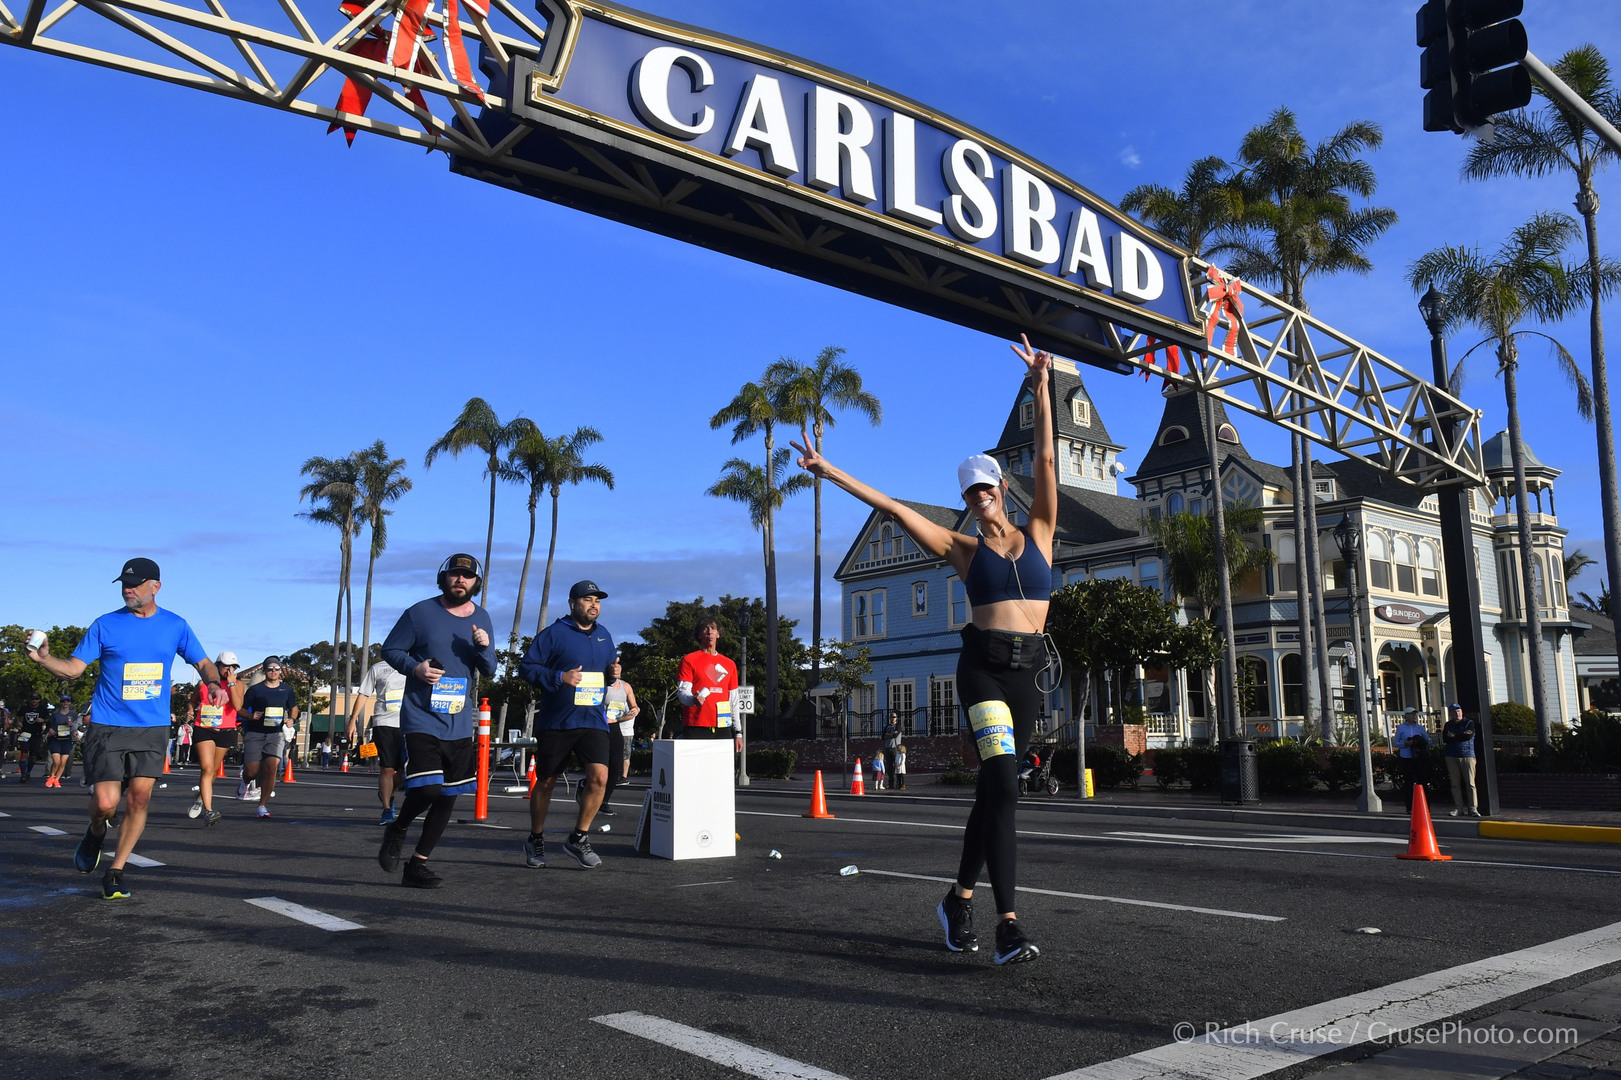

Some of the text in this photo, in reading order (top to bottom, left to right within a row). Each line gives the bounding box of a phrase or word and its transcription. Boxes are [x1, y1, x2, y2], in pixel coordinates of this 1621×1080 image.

[631, 46, 1164, 303] CARLSBAD
[1392, 609, 1404, 617] SUN
[1404, 610, 1420, 620] DIEGO
[123, 686, 145, 694] 3738
[431, 701, 450, 709] 12121
[739, 700, 753, 710] 30
[983, 726, 1009, 735] GWEN
[977, 735, 1000, 751] 3795
[653, 791, 671, 804] GORILLA
